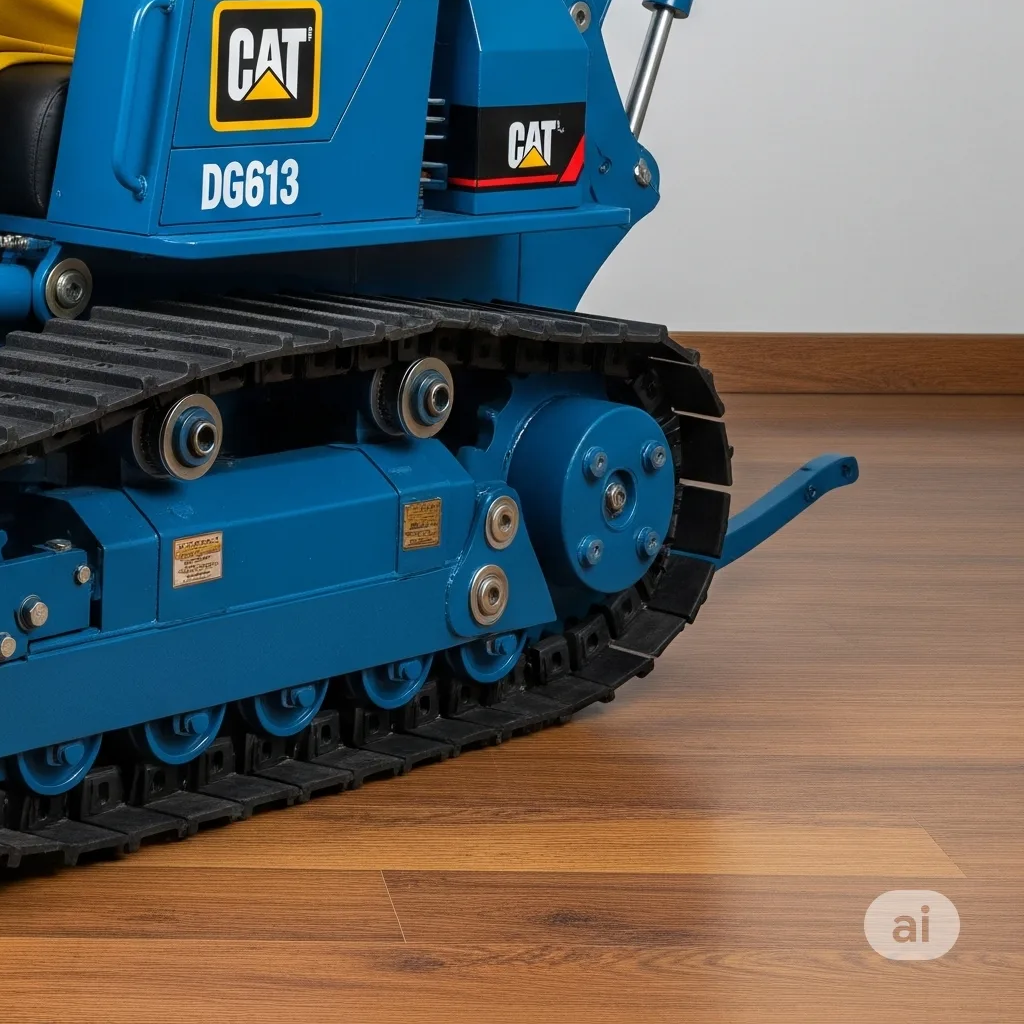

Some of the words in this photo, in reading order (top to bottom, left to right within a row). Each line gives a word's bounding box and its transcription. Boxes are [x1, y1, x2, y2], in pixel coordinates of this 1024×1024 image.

[228, 27, 307, 102] CAT
[508, 120, 557, 169] CAT
[201, 158, 299, 210] DG613
